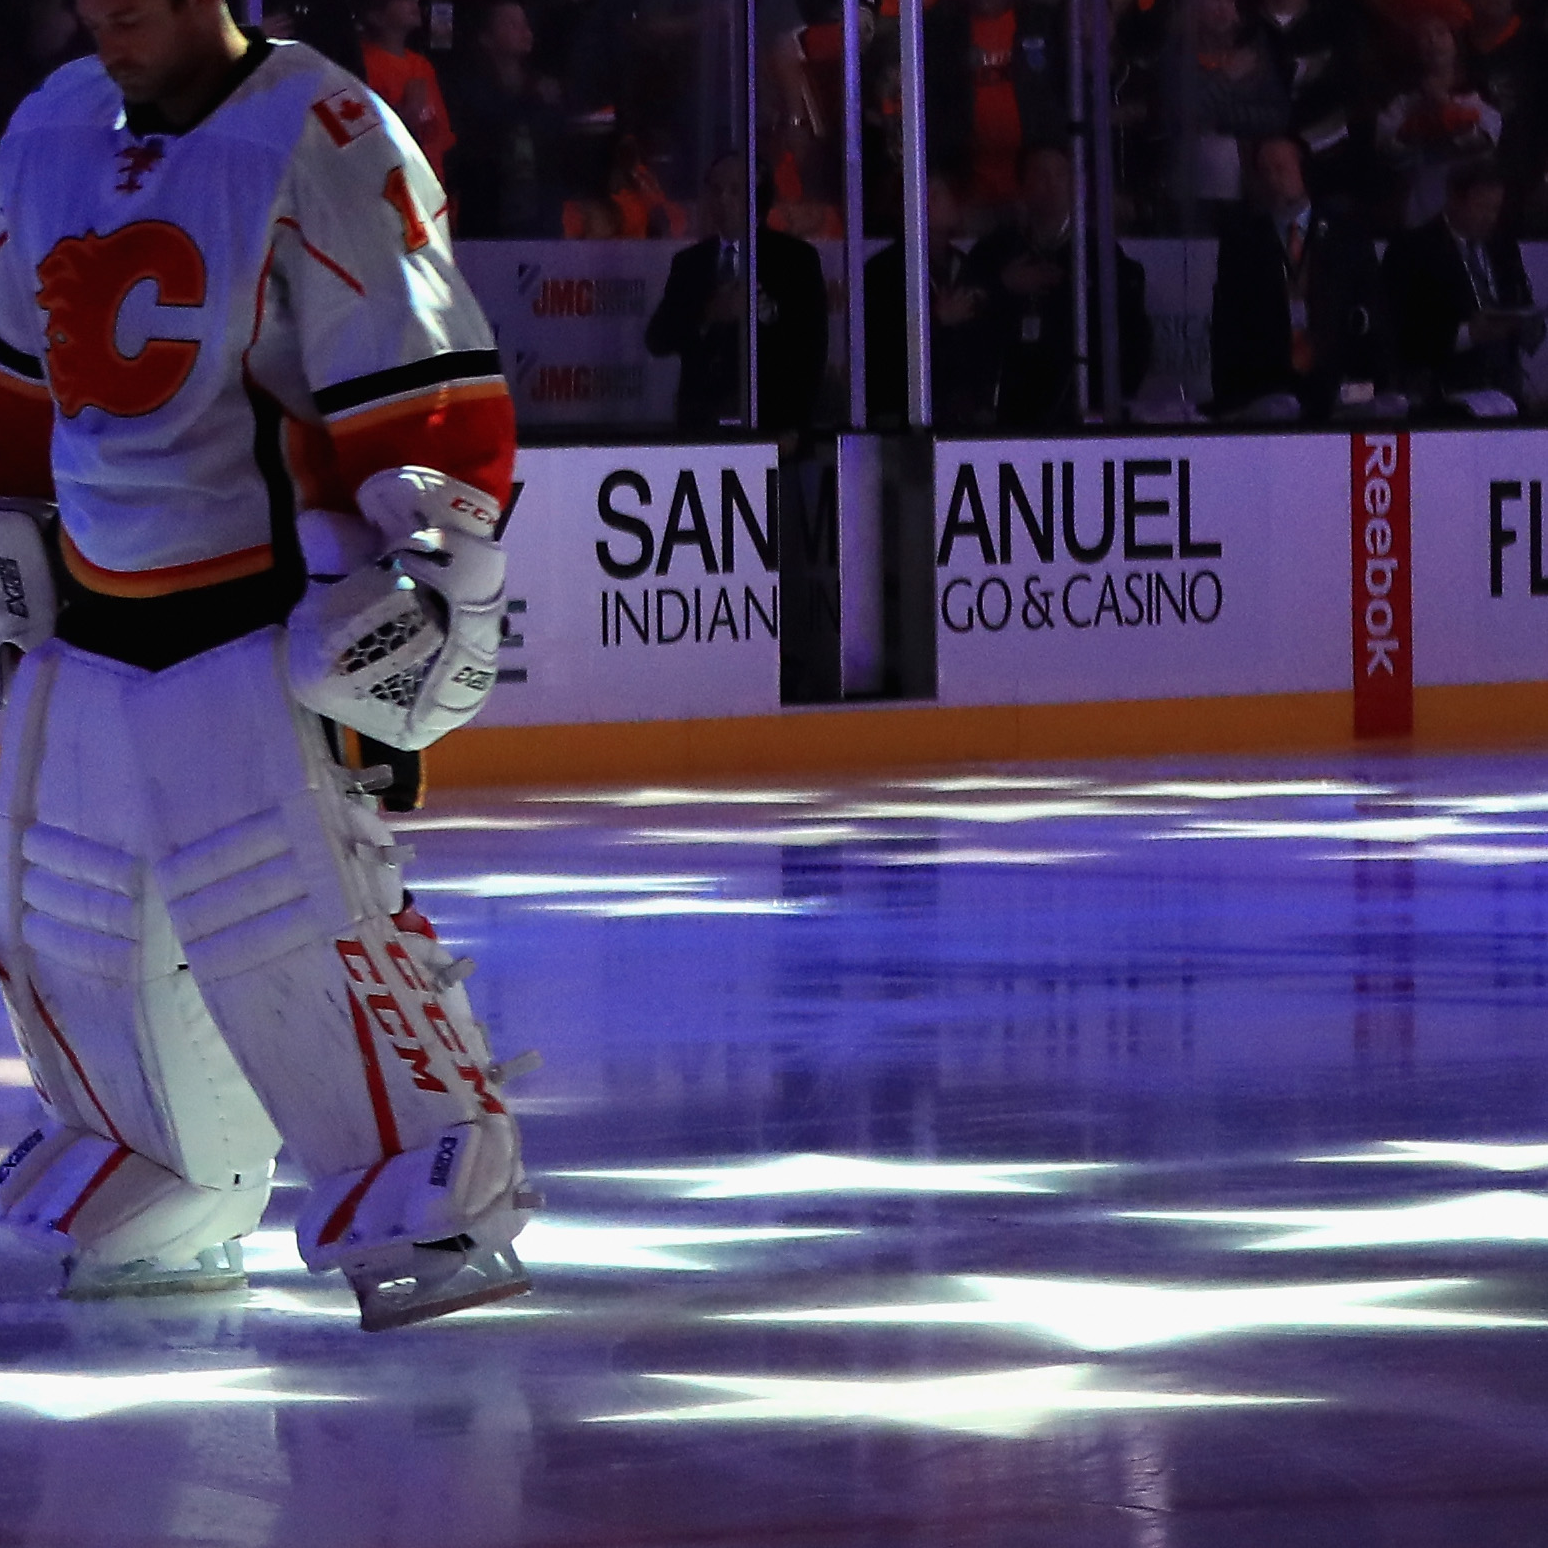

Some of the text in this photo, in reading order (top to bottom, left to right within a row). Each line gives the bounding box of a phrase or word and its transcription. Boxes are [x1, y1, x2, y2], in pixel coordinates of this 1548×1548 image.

[596, 469, 779, 581] SAN
[1363, 434, 1400, 678] Reebok
[602, 585, 779, 647] INDIAN
[1021, 574, 1055, 630] &
[1062, 569, 1224, 629] CASINO
[335, 938, 449, 1094] CCM
[384, 941, 508, 1115] CCM
